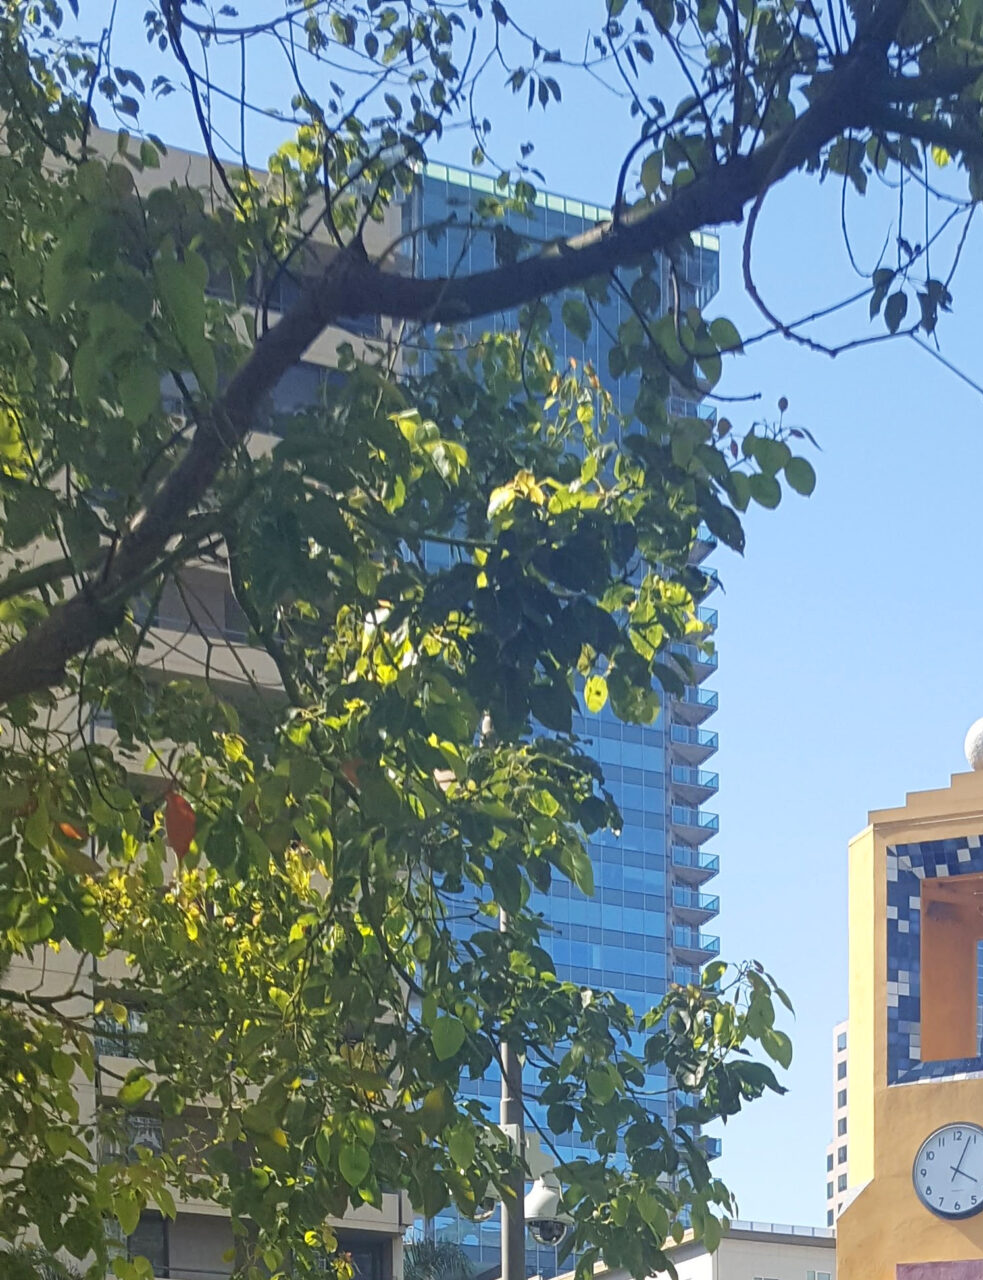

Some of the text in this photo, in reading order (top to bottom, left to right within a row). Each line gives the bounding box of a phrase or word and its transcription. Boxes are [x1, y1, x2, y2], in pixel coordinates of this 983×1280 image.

[953, 1131, 962, 1141] 12
[938, 1138, 945, 1147] 11
[926, 1151, 935, 1160] 10
[920, 1169, 927, 1177] 9
[926, 1186, 932, 1195] 8
[939, 1197, 944, 1207] 7
[971, 1196, 977, 1205] 5
[954, 1201, 960, 1210] 6
